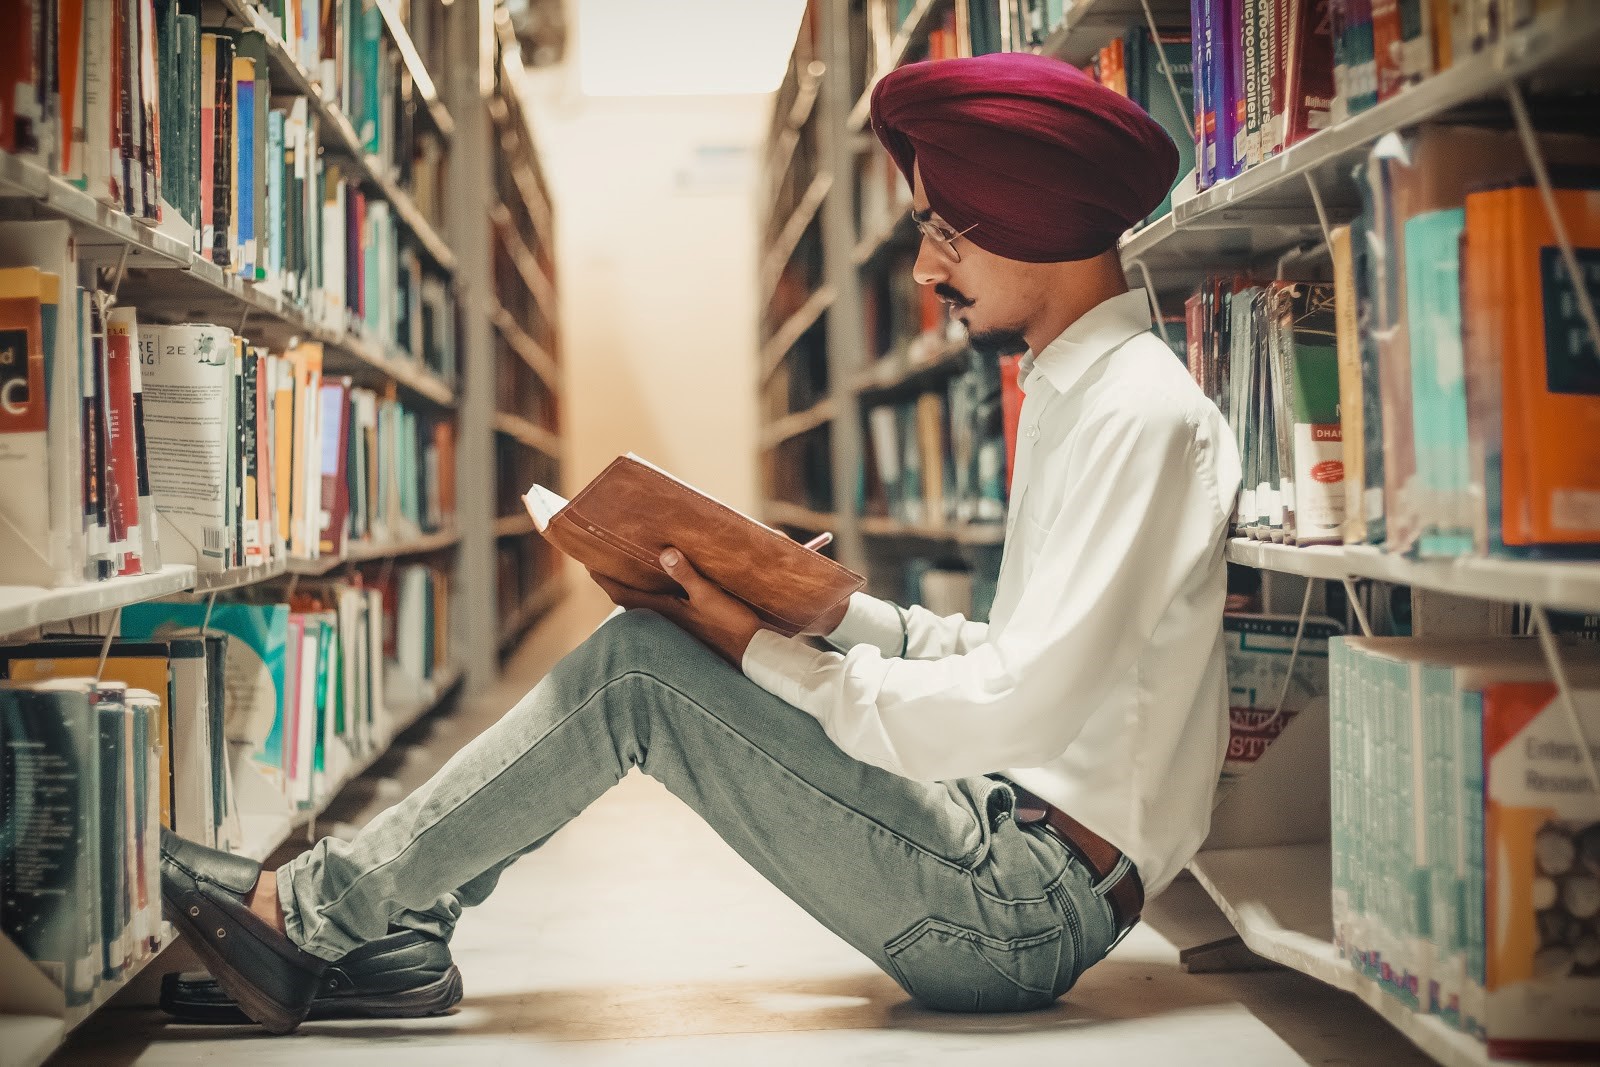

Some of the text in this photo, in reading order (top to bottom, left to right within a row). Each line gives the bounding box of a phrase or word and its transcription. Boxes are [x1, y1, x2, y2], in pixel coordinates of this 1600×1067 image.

[1244, 0, 1257, 130] icrocontrollers
[1258, 0, 1271, 124] crocontrollers
[138, 341, 186, 355] RE 2E
[139, 353, 154, 365] NG
[1, 378, 28, 415] C
